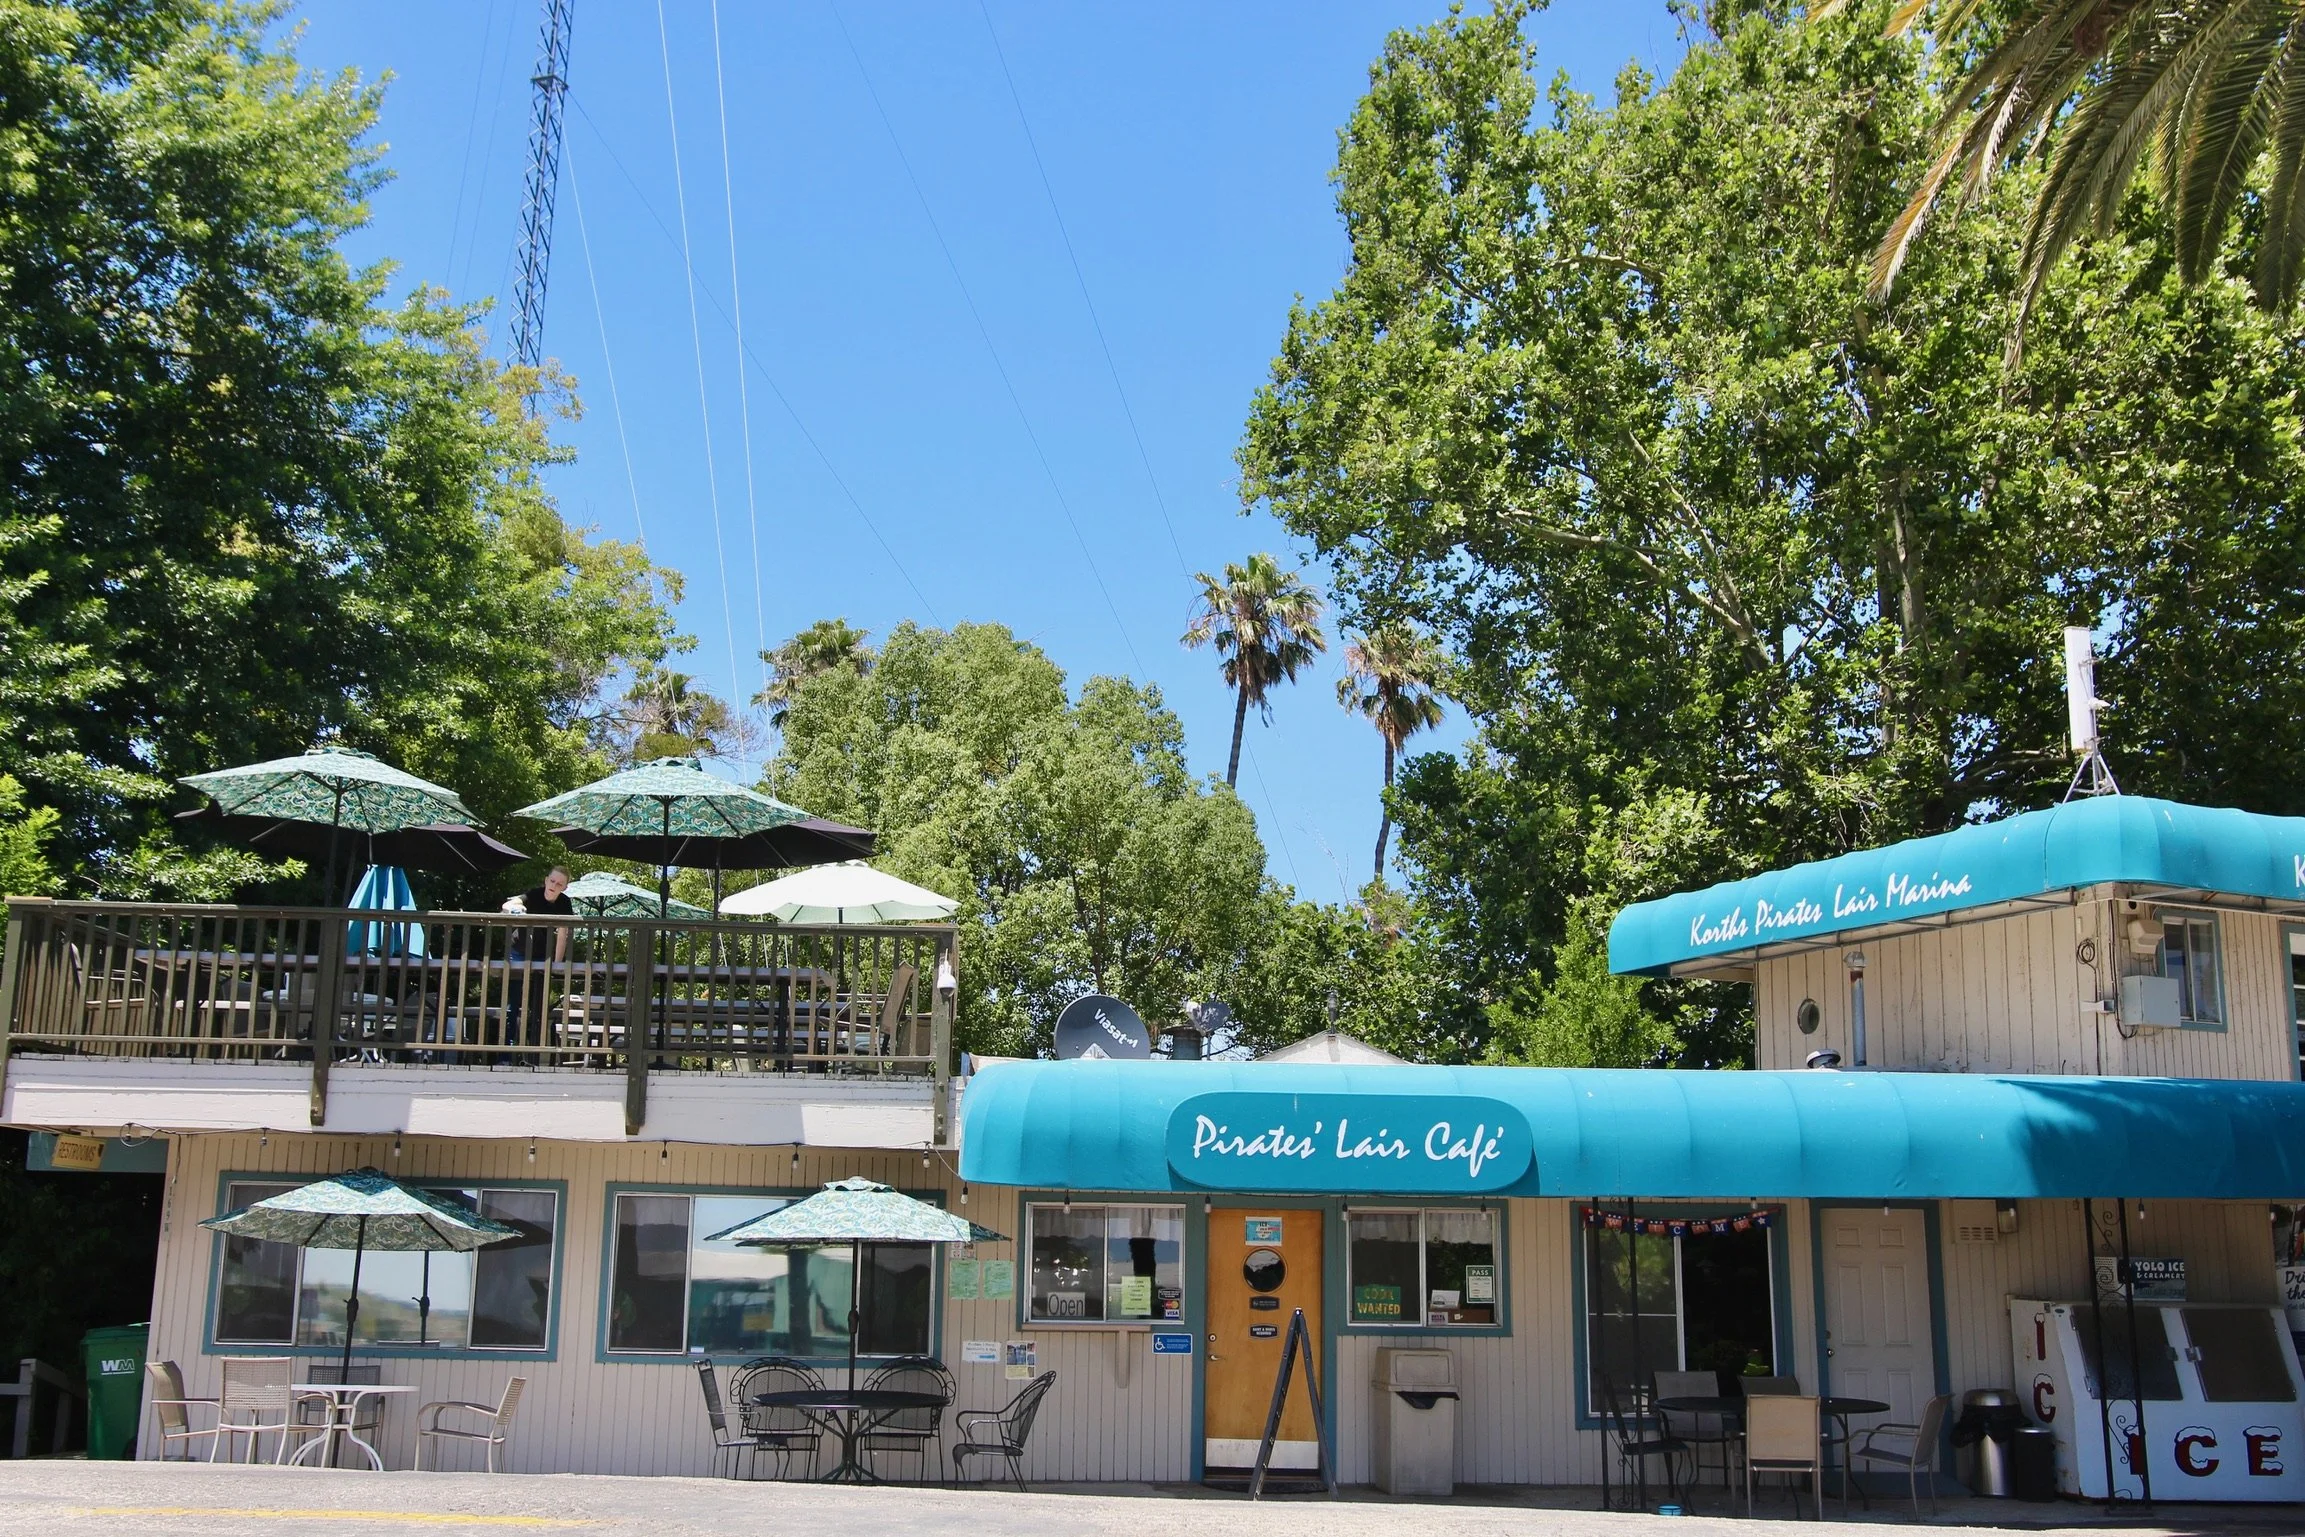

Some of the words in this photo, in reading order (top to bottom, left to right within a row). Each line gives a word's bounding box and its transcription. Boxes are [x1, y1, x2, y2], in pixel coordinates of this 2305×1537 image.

[1689, 906, 1749, 947] Korths
[1755, 898, 1823, 936] Pirates
[1834, 884, 1879, 919] Lair
[1885, 872, 1972, 909] Marina
[1094, 1008, 1127, 1045] Viasat
[1335, 1118, 1411, 1160] Lair
[59, 1141, 97, 1162] RESTROOMS
[2135, 1261, 2165, 1273] YOLO
[2168, 1261, 2185, 1273] ICE
[2144, 1272, 2185, 1280] CREAMERY
[2285, 1271, 2305, 1285] Dri
[1048, 1293, 1084, 1317] Open
[1356, 1301, 1401, 1315] WANTED
[101, 1358, 136, 1371] WM
